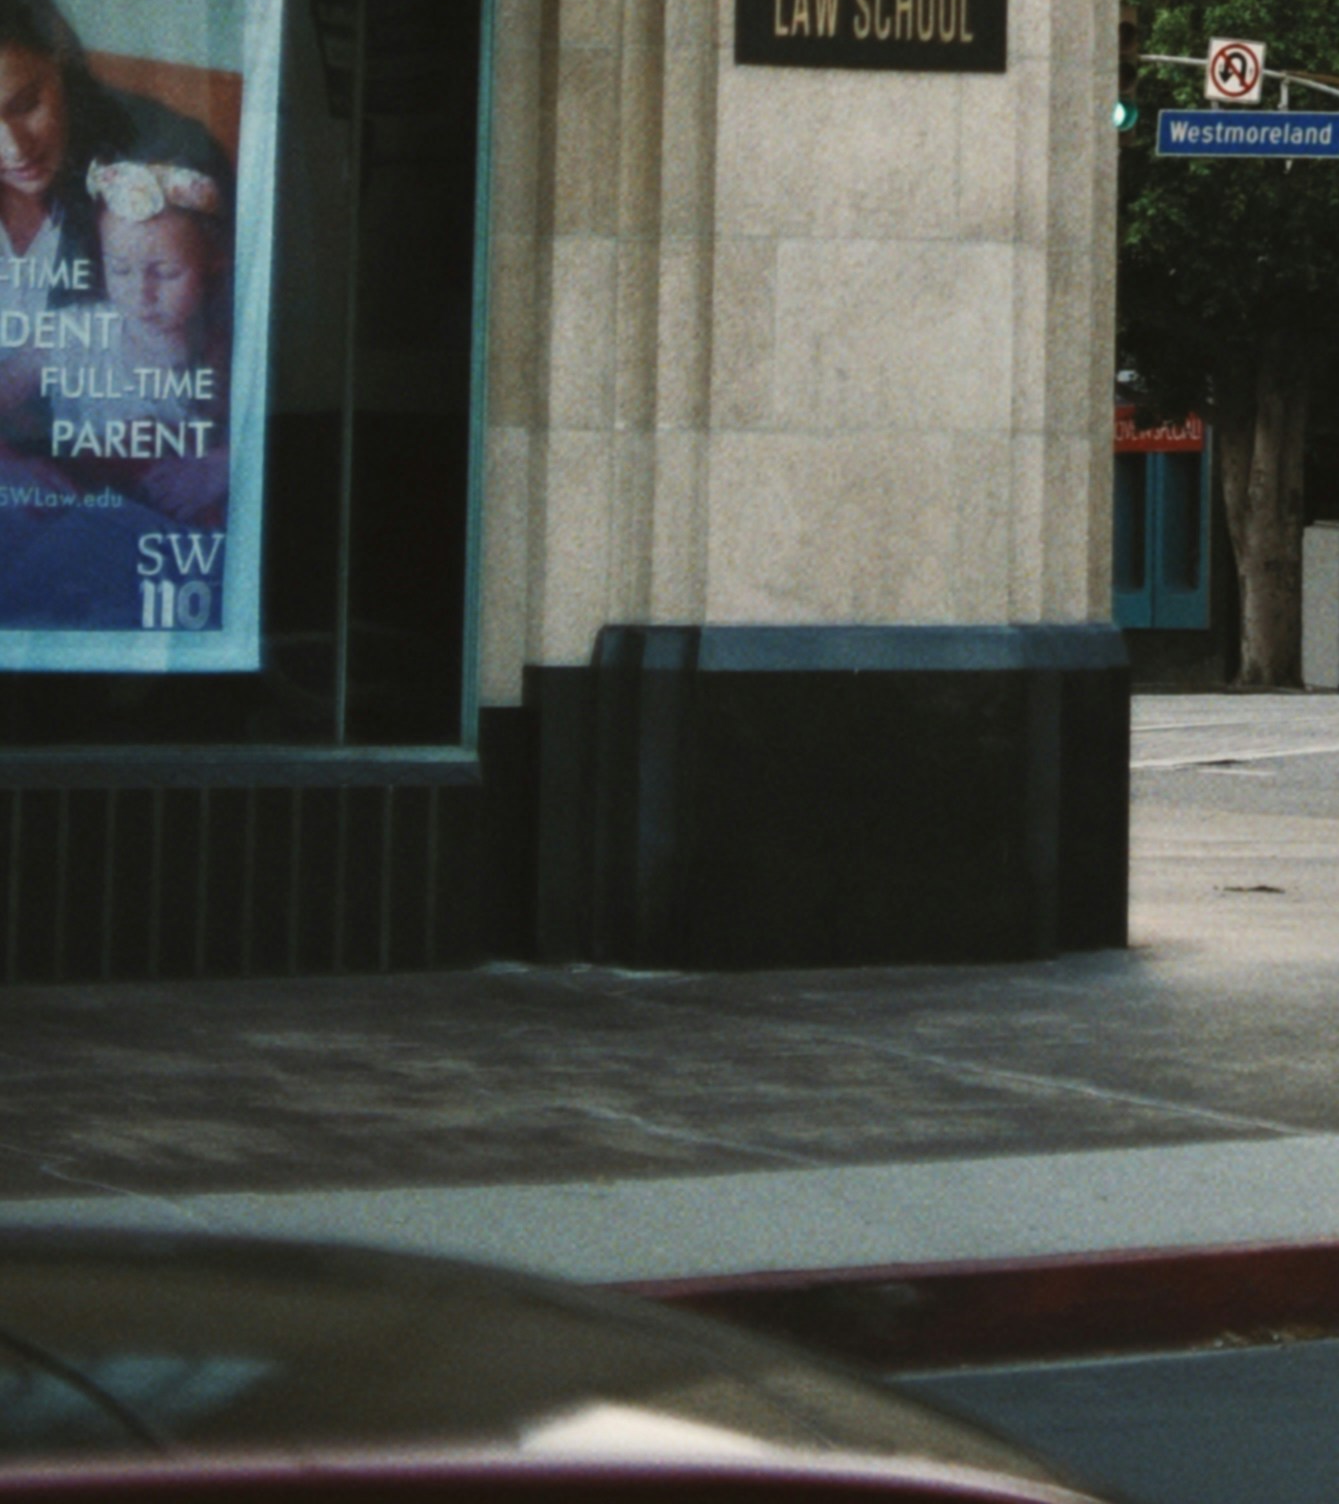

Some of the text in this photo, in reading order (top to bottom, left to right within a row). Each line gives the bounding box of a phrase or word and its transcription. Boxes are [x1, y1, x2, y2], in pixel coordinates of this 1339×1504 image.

[1170, 120, 1333, 145] Westmoreland
[40, 366, 214, 400] FULL-TIME
[52, 420, 214, 459] PARENT
[137, 533, 226, 576] SW
[139, 579, 213, 629] 110
